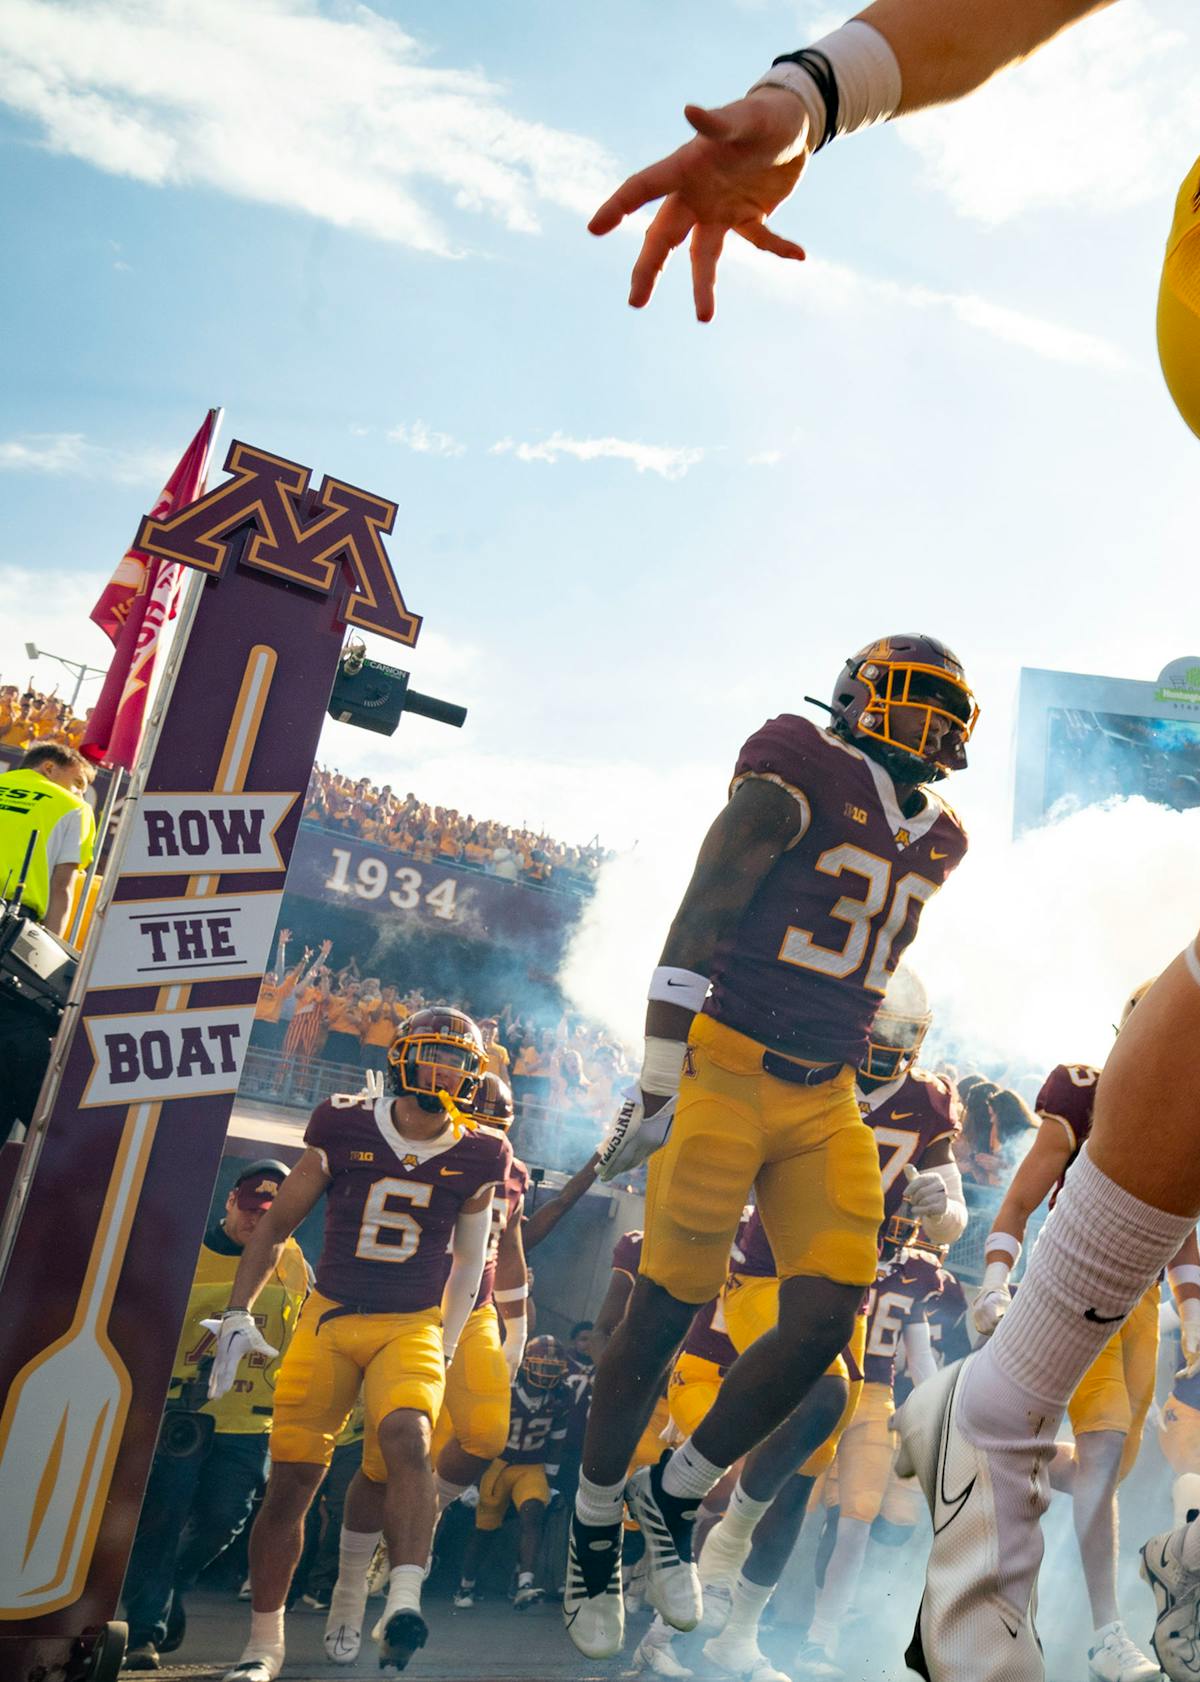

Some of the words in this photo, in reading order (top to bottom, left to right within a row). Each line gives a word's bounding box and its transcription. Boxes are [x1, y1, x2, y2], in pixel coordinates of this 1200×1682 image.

[133, 439, 423, 648] M
[144, 809, 265, 857] ROW
[325, 848, 457, 920] 1934
[140, 917, 236, 962] THE
[104, 1024, 240, 1085] BOAT
[355, 1176, 434, 1263] 6
[507, 1417, 552, 1451] 12
